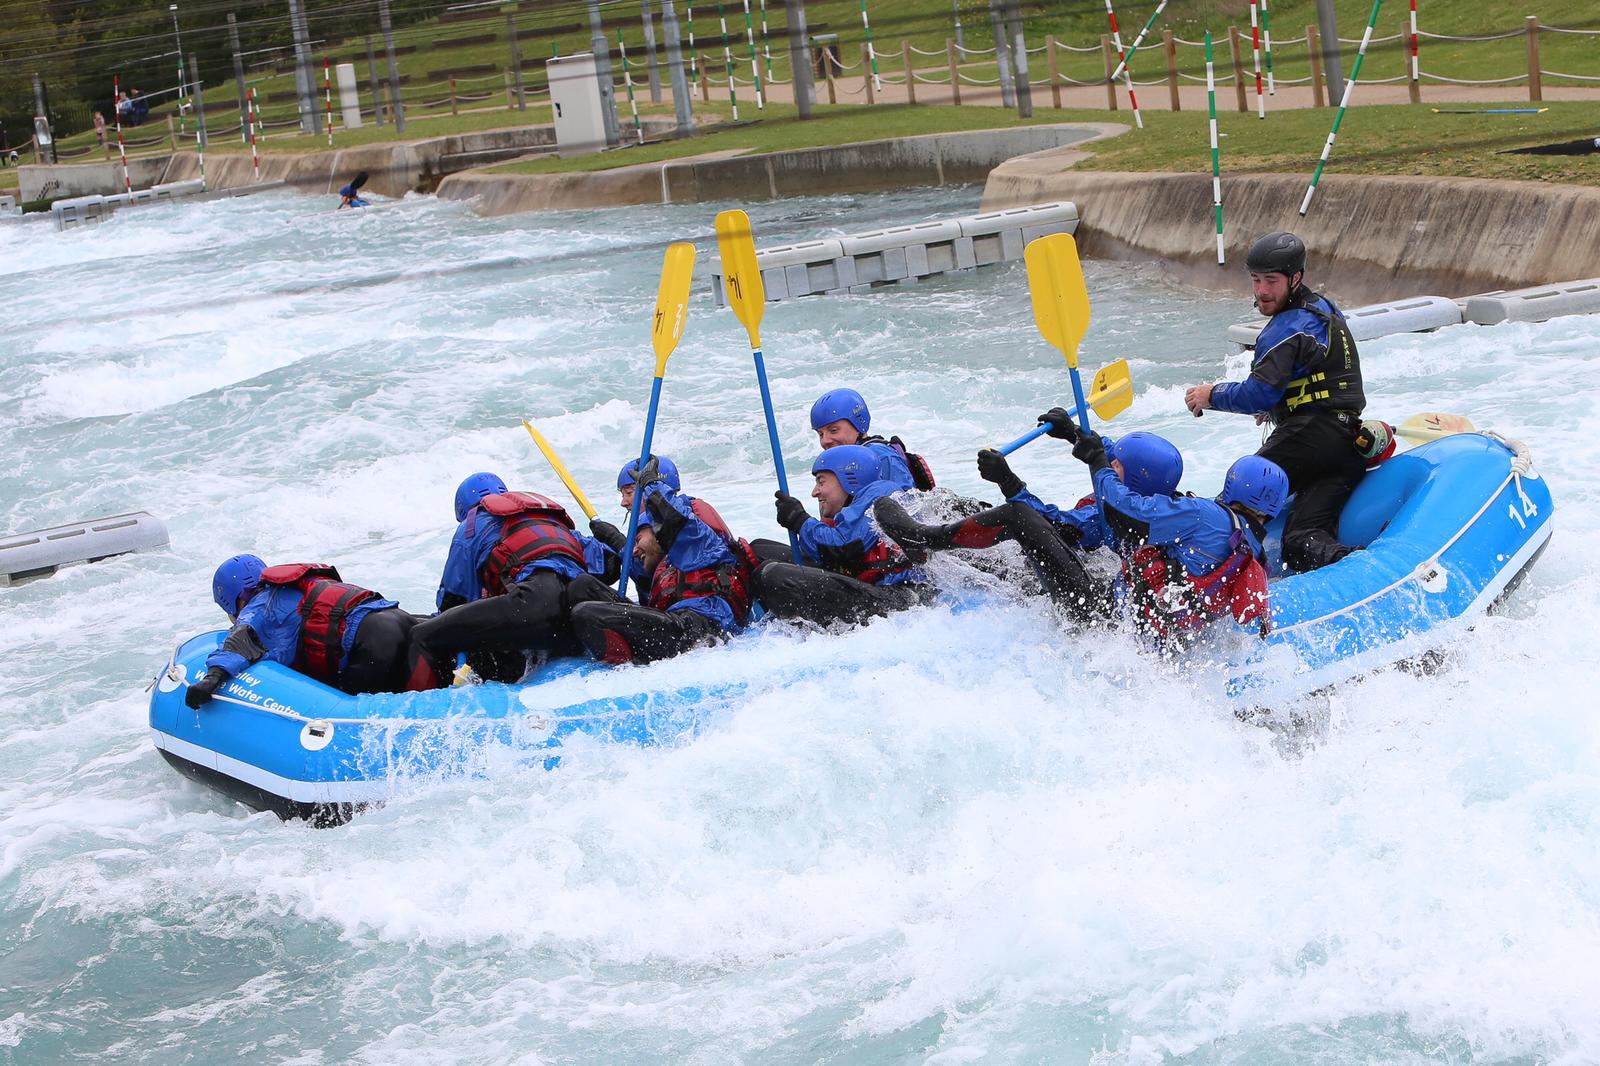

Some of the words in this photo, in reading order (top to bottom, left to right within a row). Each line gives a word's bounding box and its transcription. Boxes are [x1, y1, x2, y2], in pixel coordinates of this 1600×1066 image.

[1508, 491, 1538, 529] 14
[234, 672, 261, 687] lley
[228, 682, 263, 703] Water
